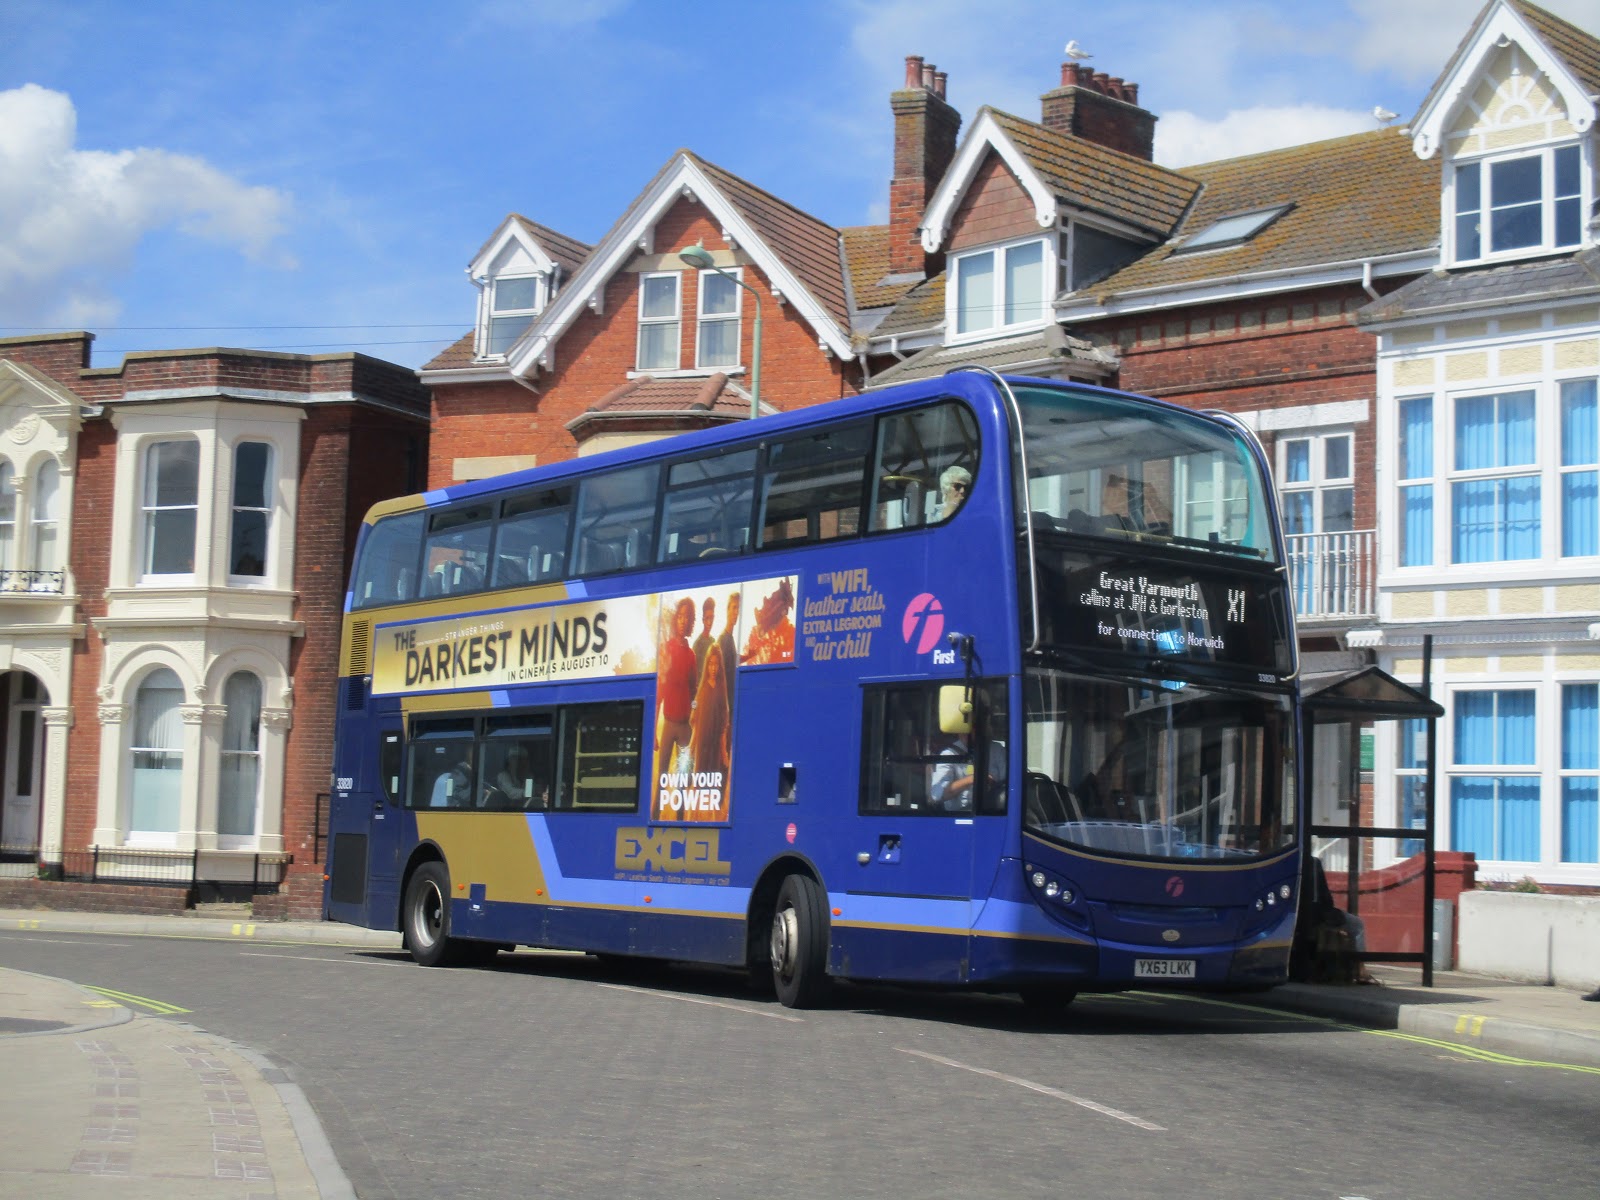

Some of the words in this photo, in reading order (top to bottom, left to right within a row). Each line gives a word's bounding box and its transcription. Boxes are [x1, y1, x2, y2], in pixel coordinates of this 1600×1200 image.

[831, 568, 872, 594] WIFI,
[1100, 571, 1135, 593] Great
[1138, 576, 1198, 601] Yarmouth
[804, 594, 849, 618] leather
[1080, 588, 1111, 608] calling
[1113, 594, 1126, 610] at
[1149, 598, 1158, 614] &
[1160, 597, 1209, 620] Gorleston
[1227, 588, 1246, 623] X1
[445, 626, 478, 641] STRANGER
[480, 621, 504, 633] THINGS
[803, 619, 833, 635] EXTRA
[834, 614, 882, 632] LEGROOM
[1097, 621, 1115, 636] for
[1173, 631, 1185, 645] to
[1187, 632, 1225, 649] Norwich
[394, 629, 417, 652] THE
[405, 630, 512, 687] DARKEST
[519, 612, 608, 667] MINDS
[507, 671, 516, 681] IN
[519, 662, 557, 680] CINEMAS
[560, 656, 596, 672] AUGUST
[599, 654, 609, 666] 10
[933, 650, 955, 665] First
[660, 773, 690, 788] OWN
[691, 772, 723, 788] YOUR
[659, 789, 721, 811] POWER
[615, 826, 731, 875] EXCEL
[1139, 961, 1168, 975] YX63
[1169, 961, 1192, 975] LKK
